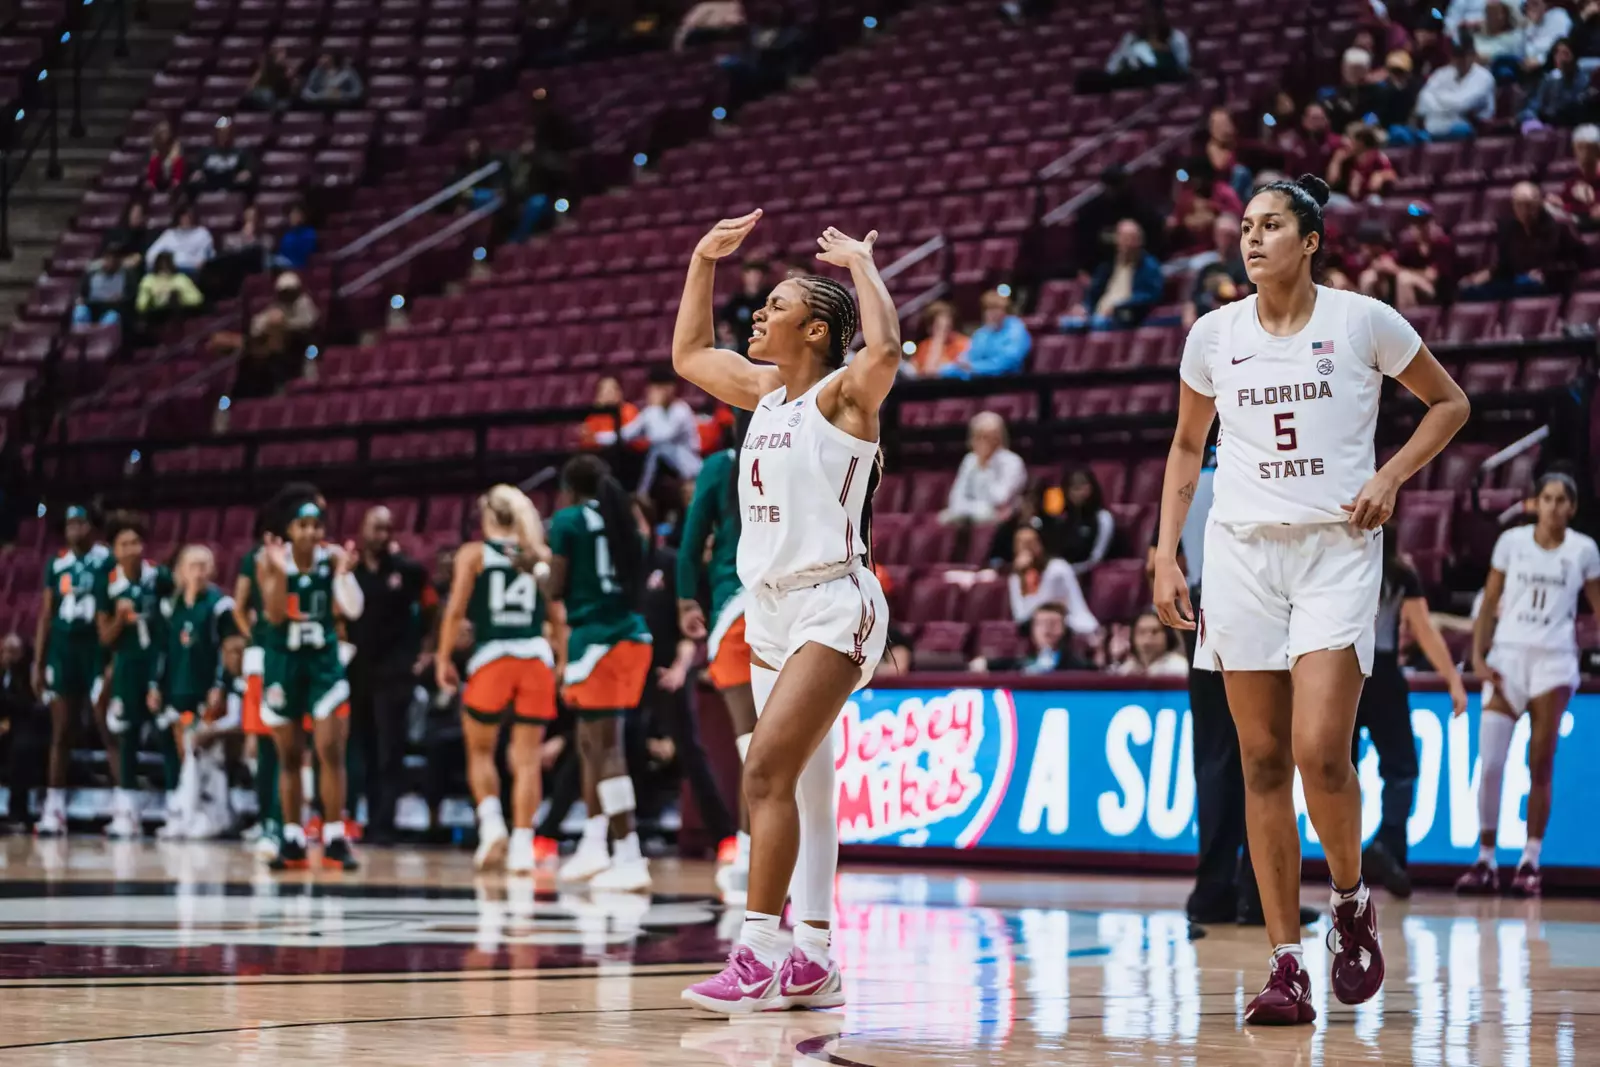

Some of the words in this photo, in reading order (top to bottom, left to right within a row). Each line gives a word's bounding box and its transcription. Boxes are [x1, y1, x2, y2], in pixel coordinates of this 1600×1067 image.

[1237, 380, 1333, 407] FLORIDA
[1273, 411, 1298, 452] 5
[751, 458, 765, 496] 4
[1258, 457, 1325, 480] STATE
[488, 570, 537, 611] 14
[1531, 588, 1548, 610] 11
[835, 700, 974, 771] Jersey
[1017, 707, 1070, 835] A
[1096, 704, 1198, 840] SU
